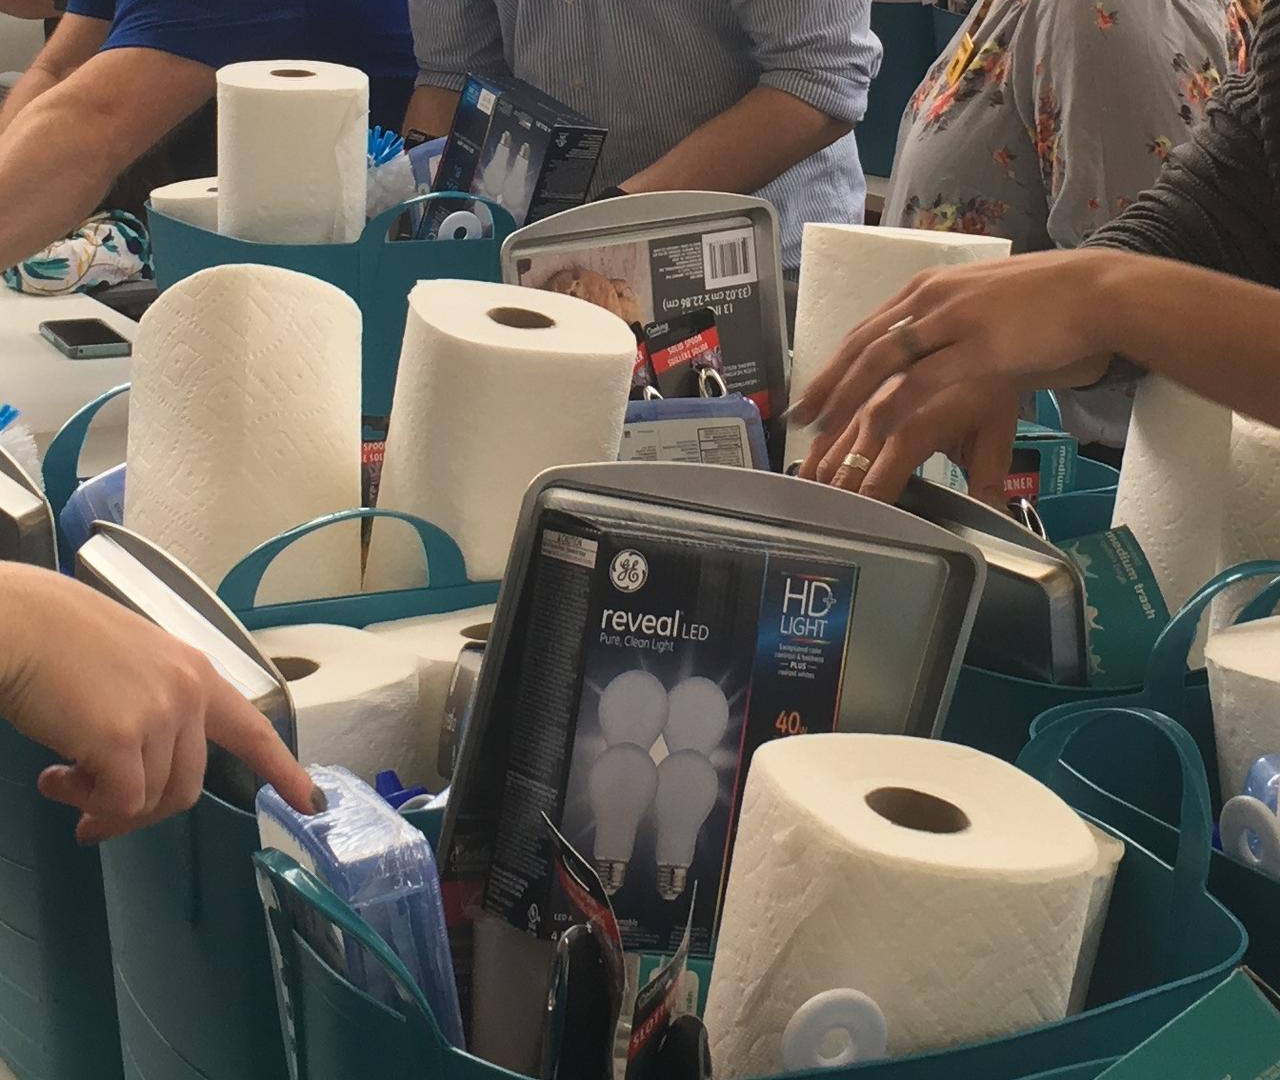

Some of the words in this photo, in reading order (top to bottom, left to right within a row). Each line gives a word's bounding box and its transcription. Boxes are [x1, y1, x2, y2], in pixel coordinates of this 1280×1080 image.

[601, 609, 680, 638] reveal
[682, 624, 710, 641] LED
[780, 615, 828, 638] LIGHT
[624, 635, 650, 649] Clean
[651, 639, 674, 654] Light
